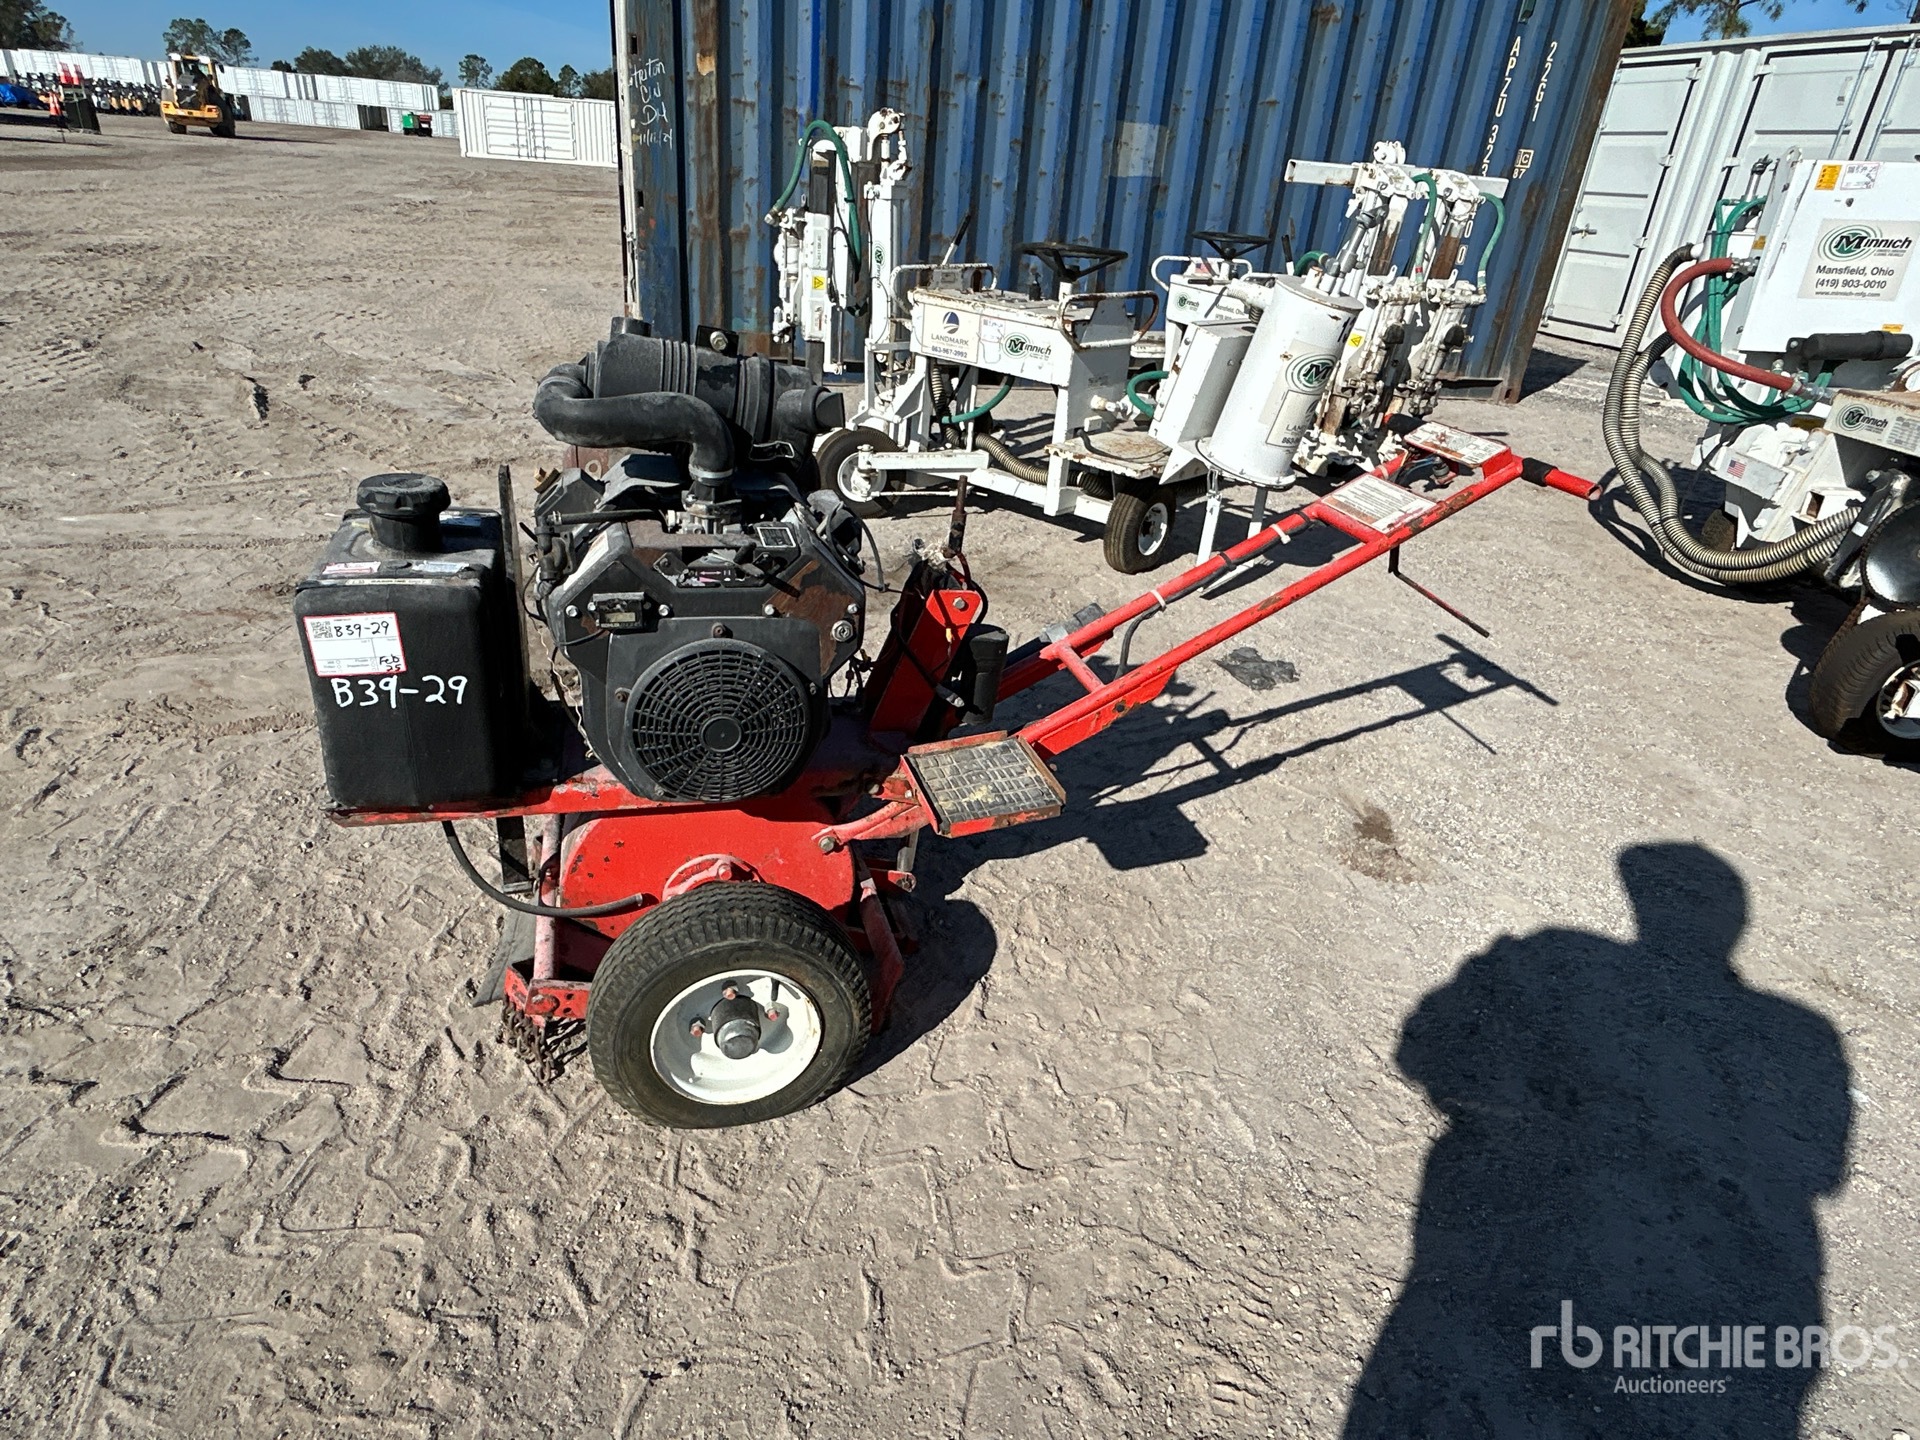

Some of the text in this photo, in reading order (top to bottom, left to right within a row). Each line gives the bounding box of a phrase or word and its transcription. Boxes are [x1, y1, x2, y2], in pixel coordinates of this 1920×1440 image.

[1495, 36, 1521, 117] APZU
[1532, 41, 1558, 122] 22G1
[1833, 235, 1912, 249] Minnich
[1816, 265, 1894, 277] Mansfield, Ohio
[1815, 278, 1887, 289] (419) 903-0010
[1007, 337, 1052, 356] Minnich
[1844, 411, 1889, 429] Minnich
[334, 620, 390, 638] B39-29
[379, 654, 401, 665] Feb
[330, 675, 468, 709] B39-29
